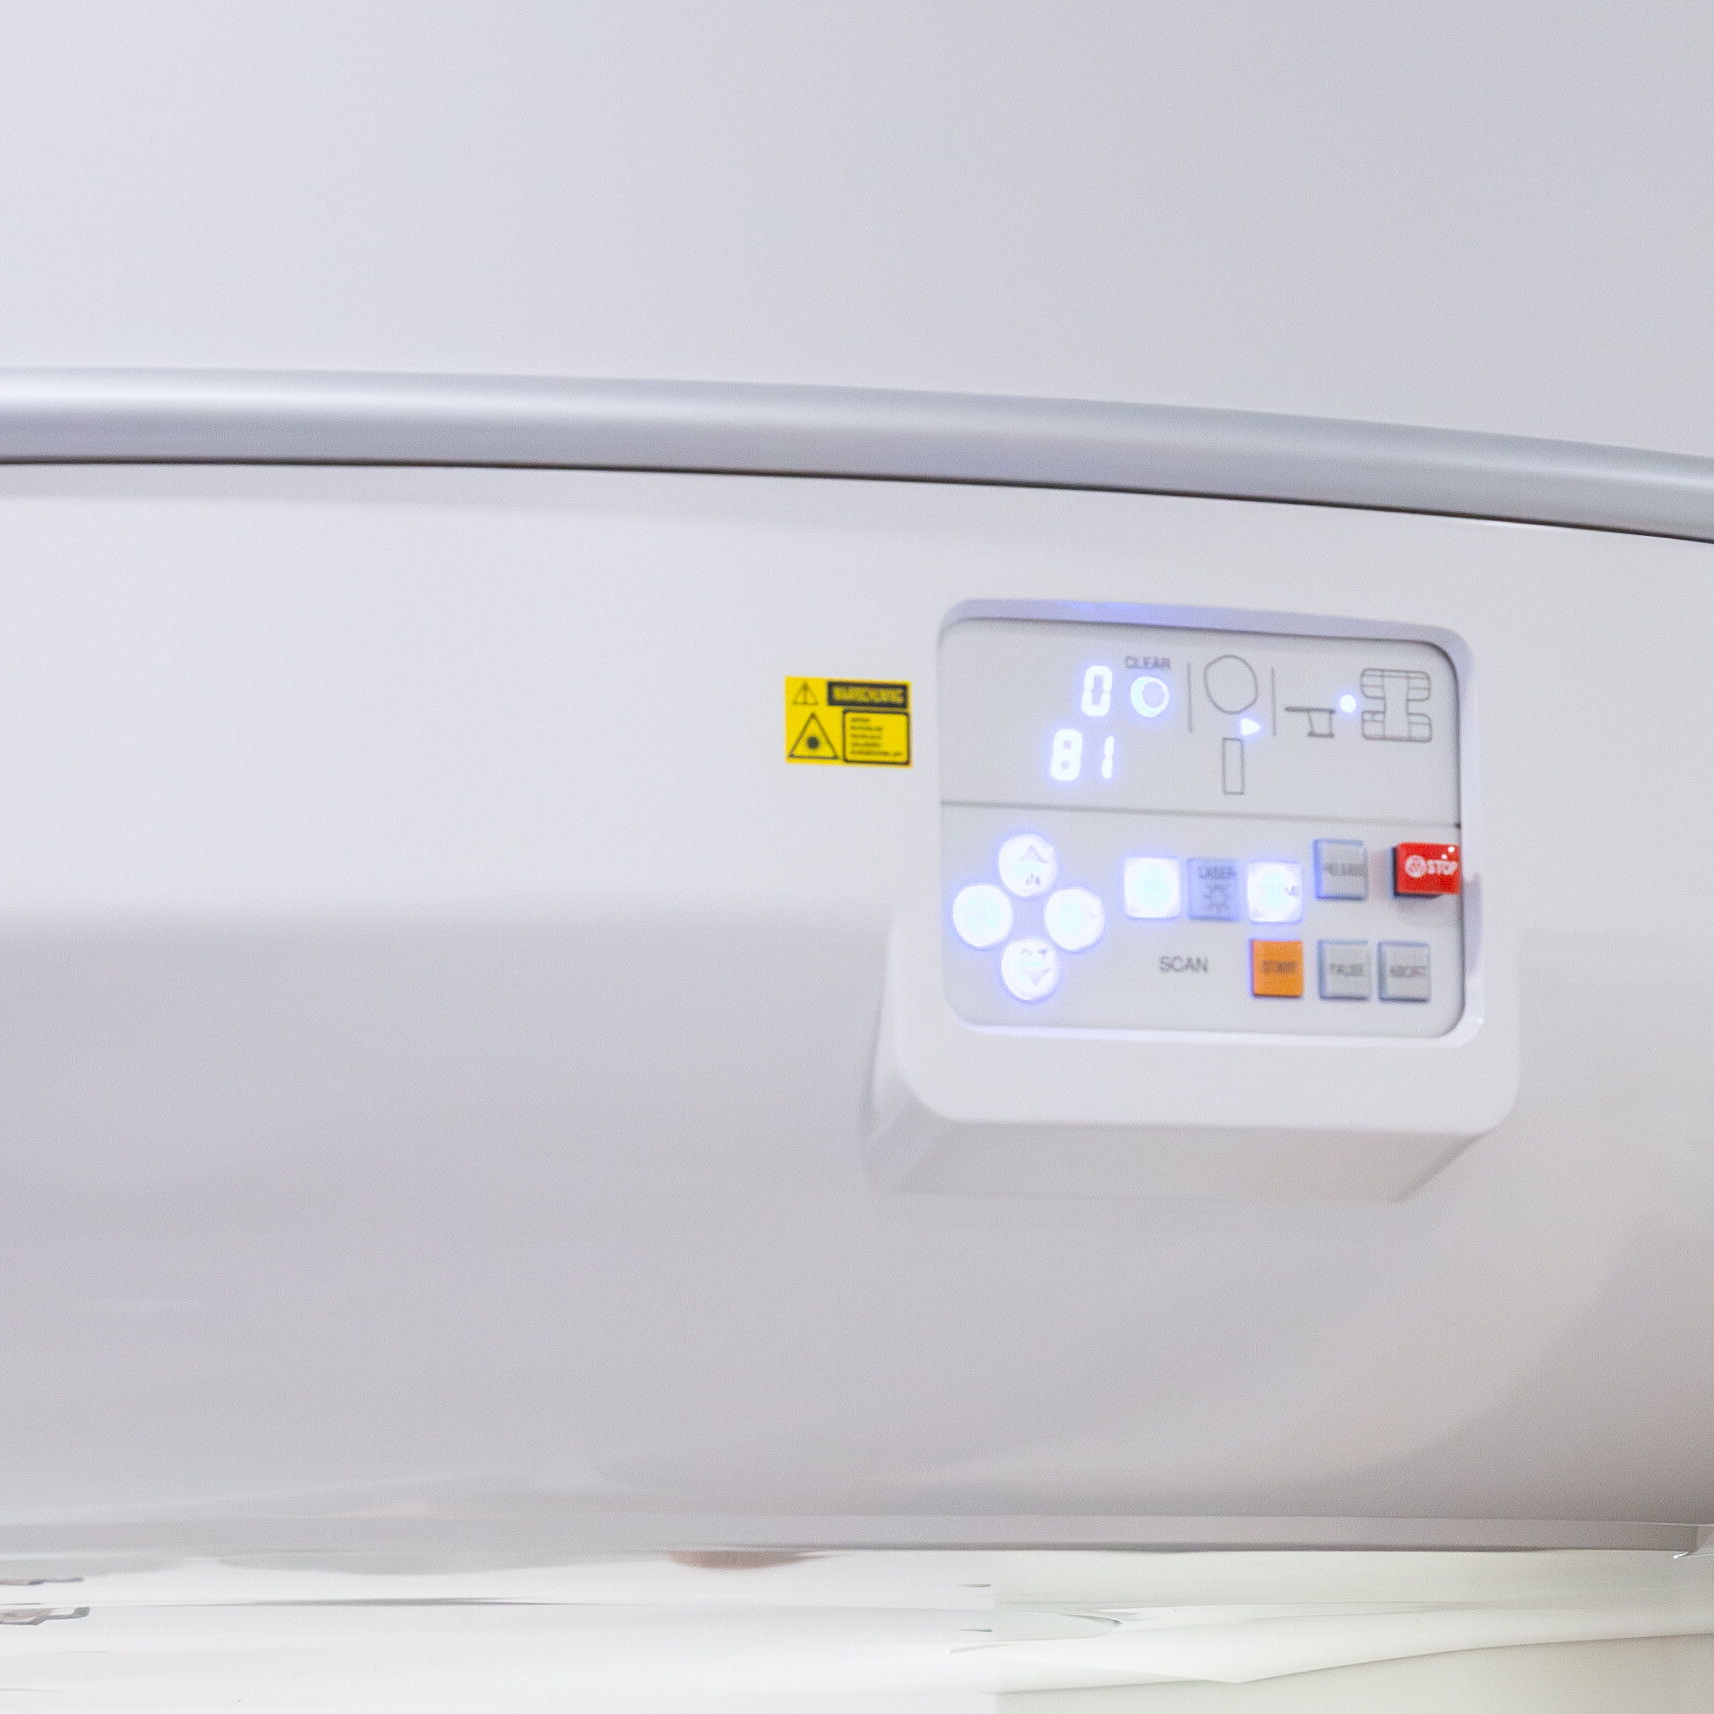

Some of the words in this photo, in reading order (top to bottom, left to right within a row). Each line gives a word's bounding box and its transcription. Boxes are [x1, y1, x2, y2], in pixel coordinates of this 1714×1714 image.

[1124, 655, 1171, 670] CLEAR
[1050, 728, 1116, 782] 81
[1426, 858, 1459, 876] STOP
[1158, 955, 1209, 974] SCAN
